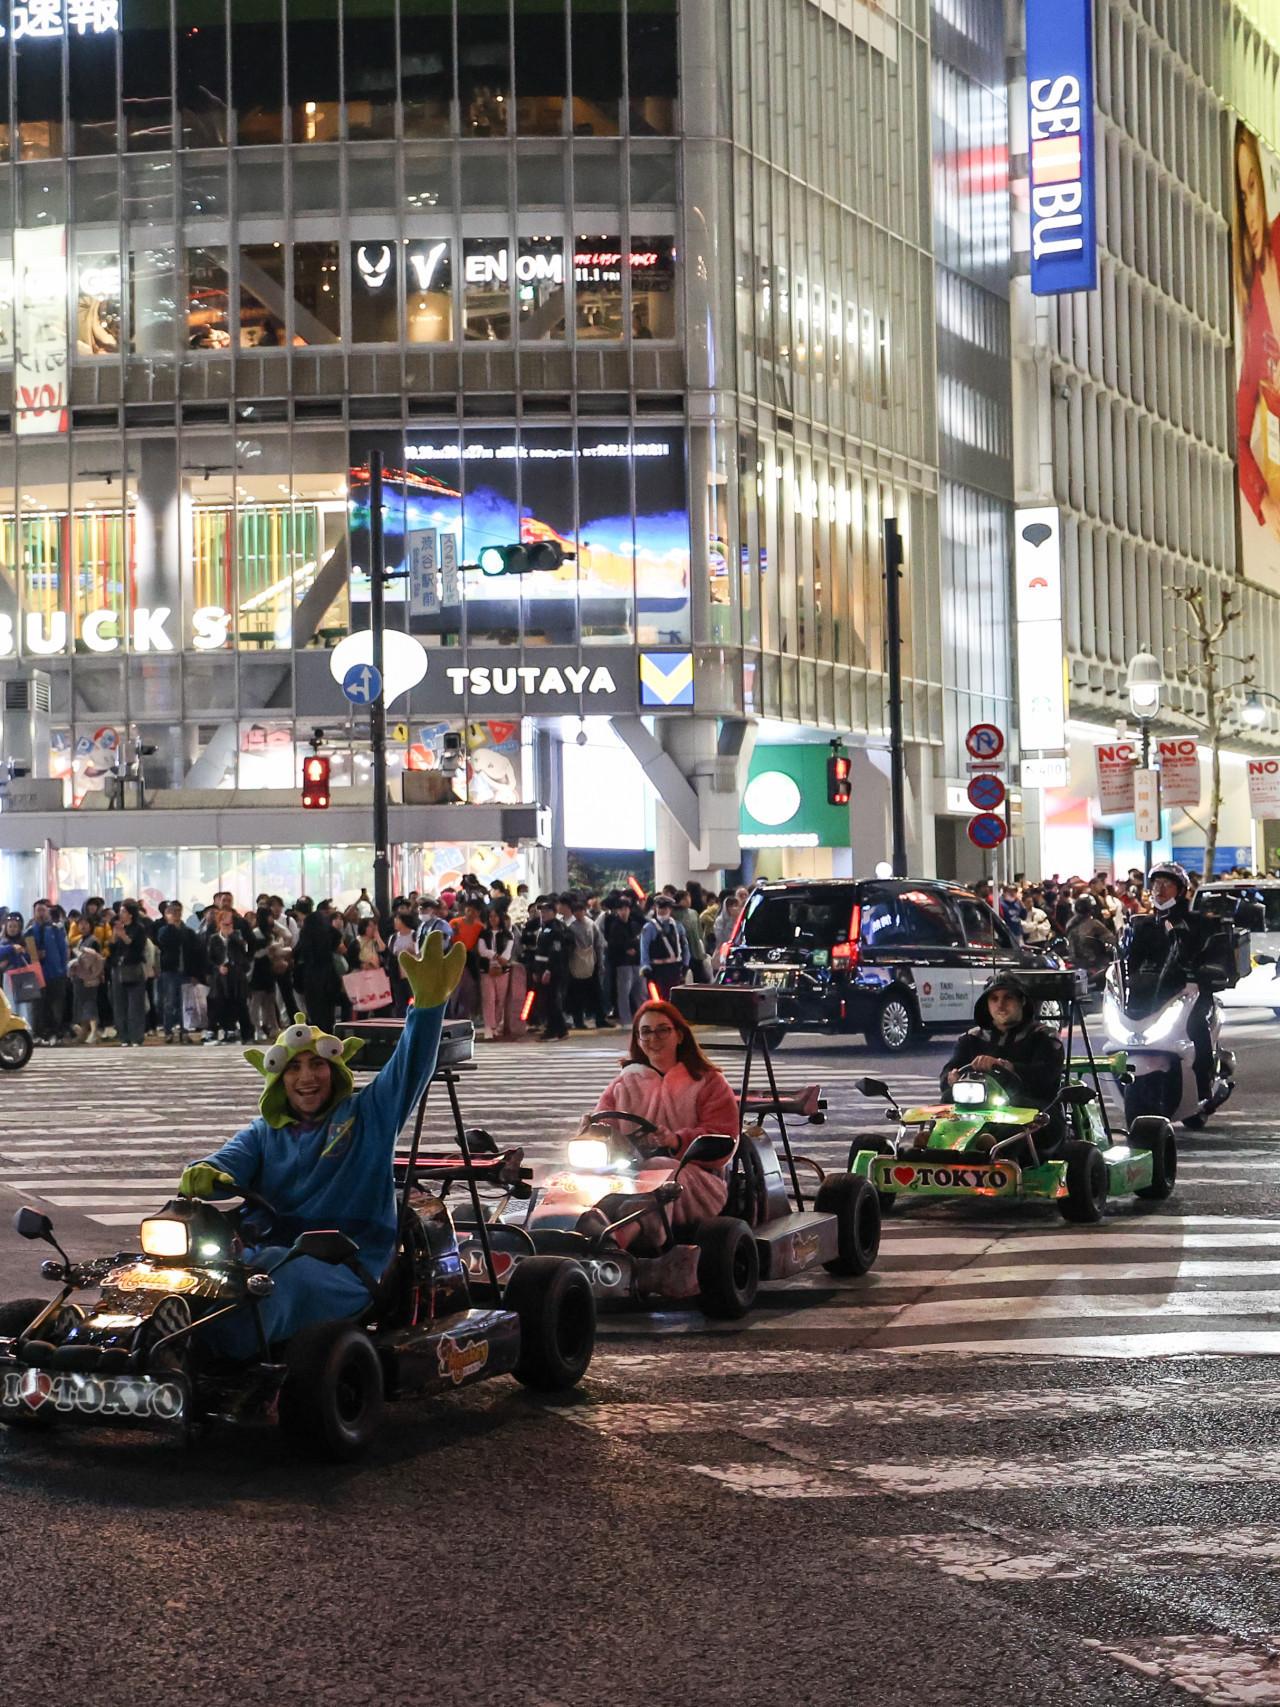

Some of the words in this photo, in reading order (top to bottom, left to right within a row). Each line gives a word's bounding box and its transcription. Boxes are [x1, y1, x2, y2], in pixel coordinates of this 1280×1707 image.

[1030, 75, 1083, 260] SEIBU
[410, 243, 562, 290] VENOM
[575, 267, 600, 281] 11.1
[602, 271, 621, 281] FRI
[421, 535, 435, 607] 渋谷駅前
[446, 666, 616, 696] TSUTAYA
[1098, 745, 1134, 762] NO
[1160, 741, 1196, 756] NO
[1249, 761, 1279, 775] NO
[882, 1167, 892, 1185] I
[917, 1168, 1007, 1188] TOKYO
[52, 1376, 183, 1419] TOKYO
